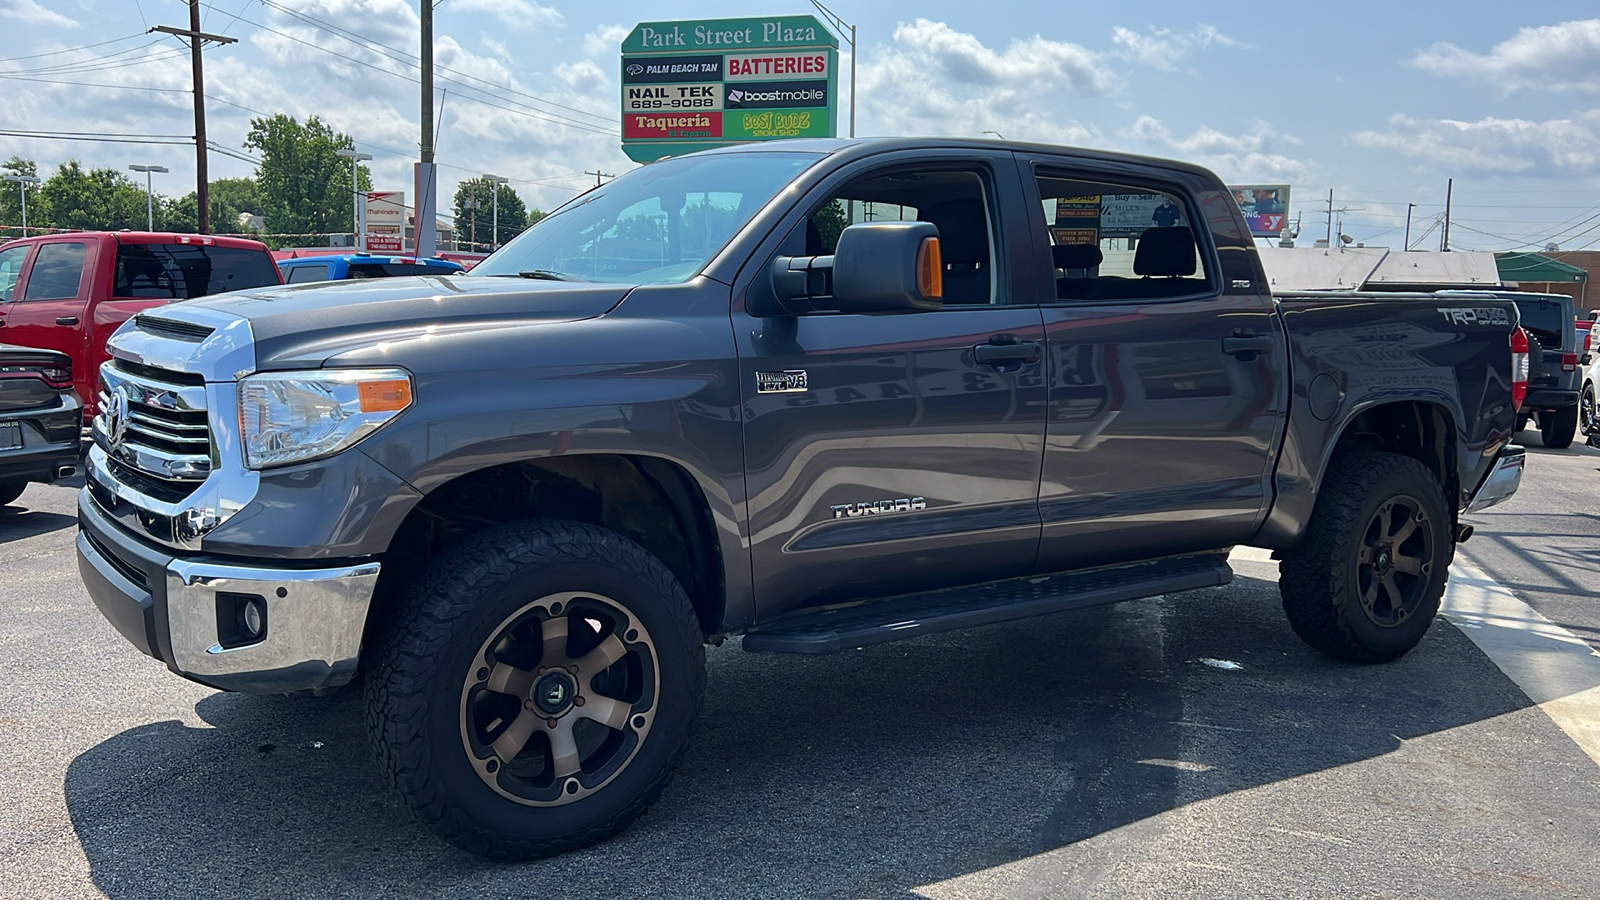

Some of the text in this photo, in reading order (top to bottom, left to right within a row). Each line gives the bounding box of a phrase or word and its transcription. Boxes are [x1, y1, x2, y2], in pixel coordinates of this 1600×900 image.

[640, 21, 816, 47] Park Street Plaza
[646, 63, 718, 74] PALM BEACH TAN
[729, 56, 825, 75] BATTERIES
[629, 86, 714, 99] NAIL TEK
[631, 99, 714, 109] 689-9088
[1436, 307, 1477, 325] TRD
[830, 497, 926, 519] TUNDRA
